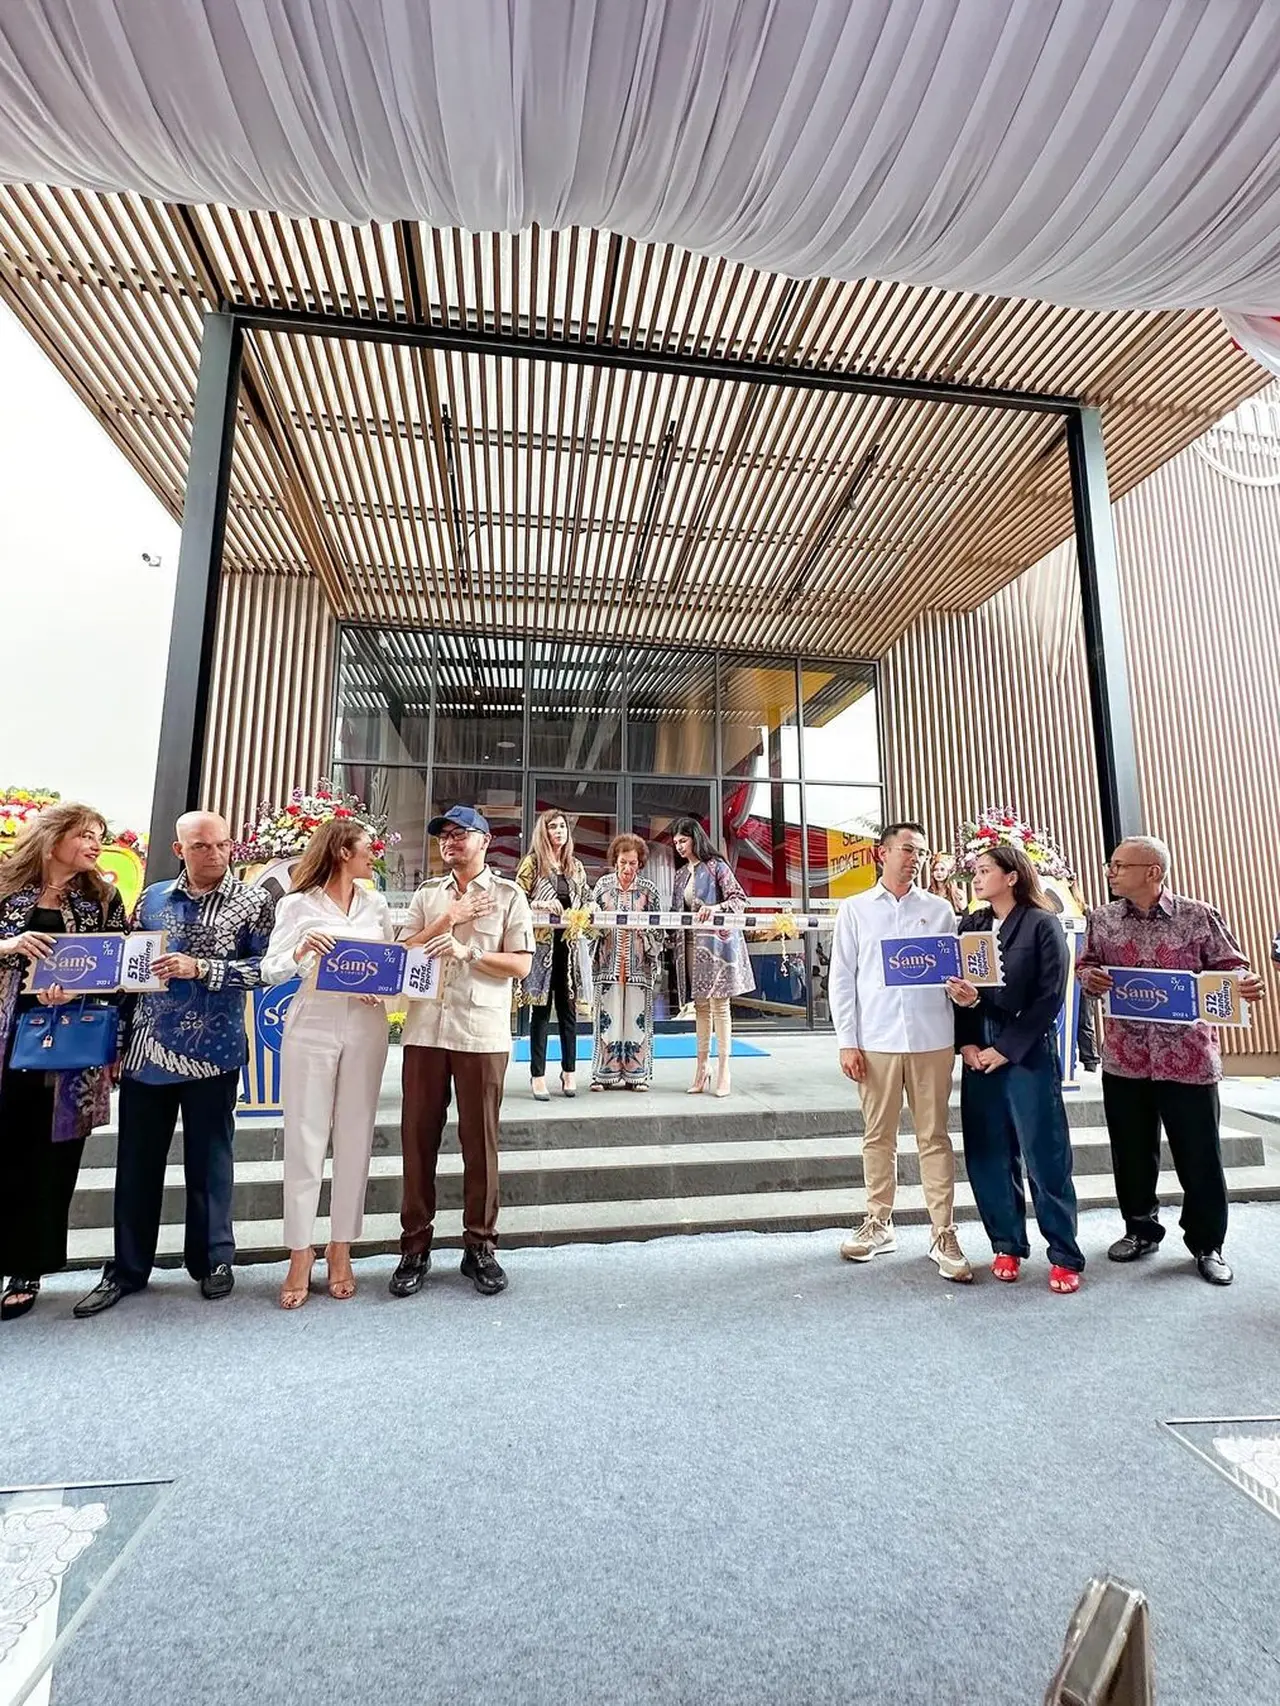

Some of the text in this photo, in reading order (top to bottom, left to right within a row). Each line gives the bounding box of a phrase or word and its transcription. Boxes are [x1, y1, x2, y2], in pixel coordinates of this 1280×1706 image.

[830, 846, 876, 874] TICKETIN
[127, 957, 139, 980] 512
[138, 955, 146, 983] grand
[409, 967, 421, 989] 512
[424, 958, 433, 990] openin
[967, 955, 978, 975] 512
[418, 965, 427, 993] grand
[1206, 994, 1217, 1015] 512
[1218, 993, 1226, 1018] grand
[1224, 980, 1232, 1016] opening
